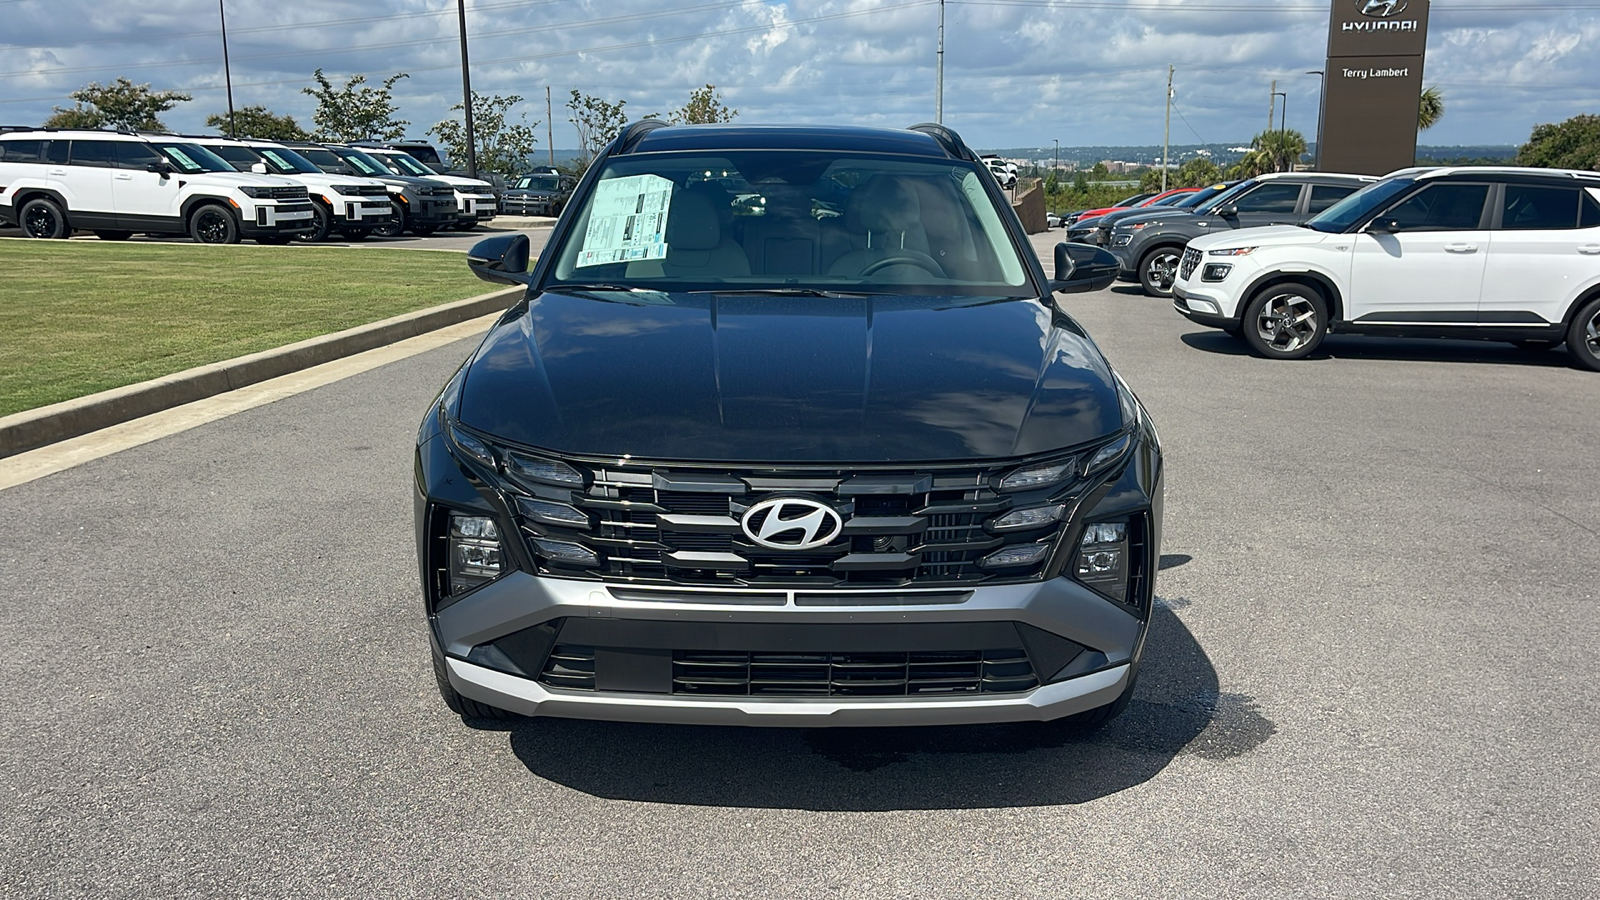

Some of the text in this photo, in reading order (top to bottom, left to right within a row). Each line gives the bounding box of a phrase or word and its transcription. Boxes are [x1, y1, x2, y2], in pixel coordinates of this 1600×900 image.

[1342, 20, 1417, 32] HYUNDAI
[1342, 67, 1408, 80] Terry Lambert
